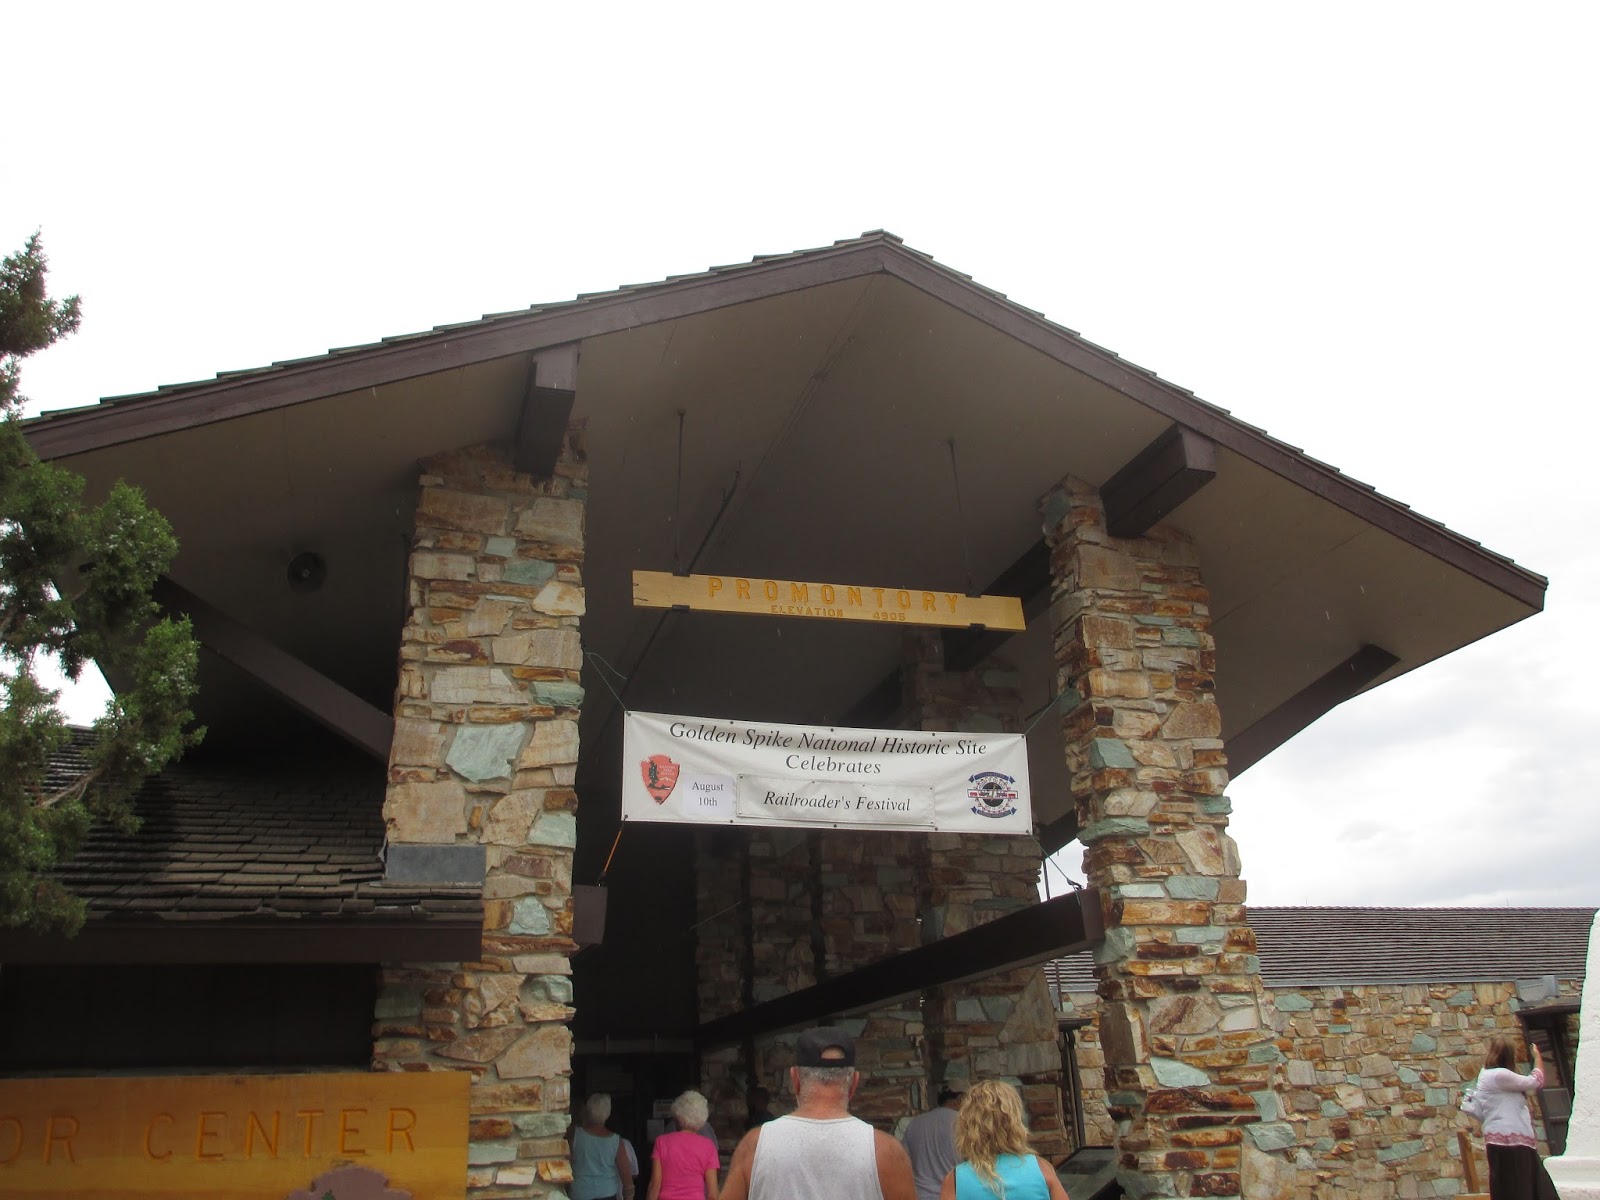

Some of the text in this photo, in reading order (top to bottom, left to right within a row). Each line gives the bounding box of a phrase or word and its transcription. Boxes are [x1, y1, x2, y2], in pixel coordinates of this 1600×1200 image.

[707, 577, 961, 614] PROMONTORY
[770, 604, 844, 618] ELEVATION
[669, 722, 987, 755] Golden Spike National Historic Site
[786, 754, 881, 774] Celebrates
[692, 781, 724, 793] August
[698, 797, 718, 807] 10th
[763, 791, 911, 811] Railroader's Festival
[143, 1107, 418, 1162] CENTER
